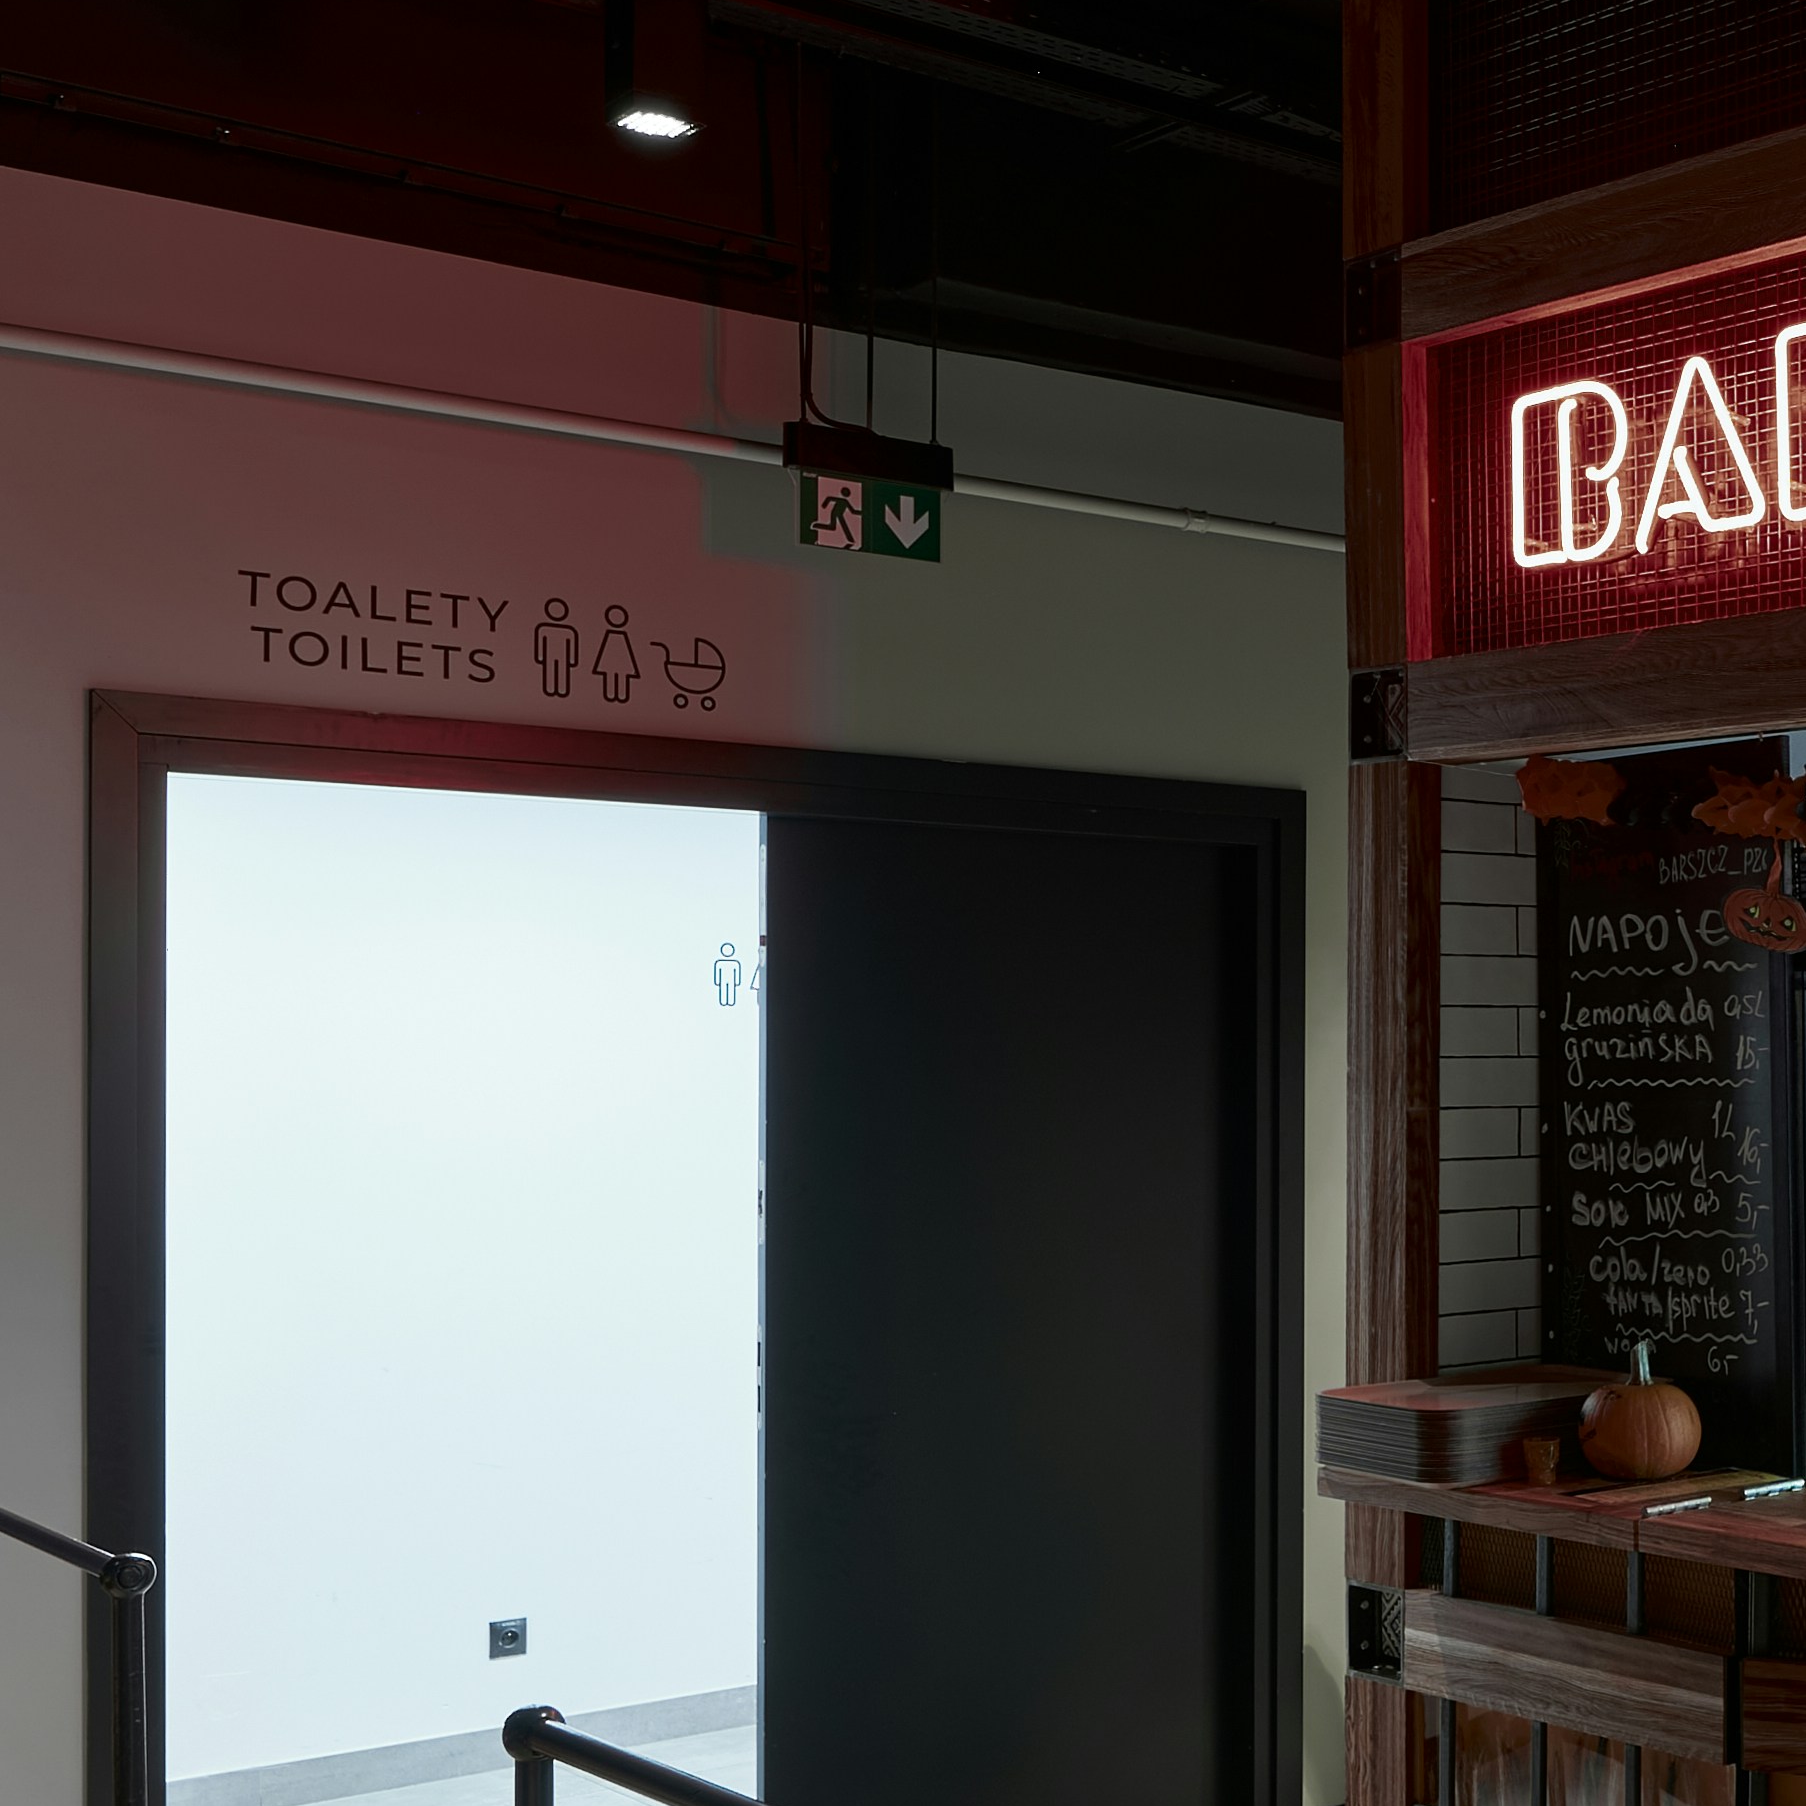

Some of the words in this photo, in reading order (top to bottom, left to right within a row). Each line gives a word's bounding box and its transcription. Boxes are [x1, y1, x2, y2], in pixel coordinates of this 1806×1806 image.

[237, 569, 510, 633] TOALETY
[250, 625, 496, 684] TOILETS
[1646, 1190, 1685, 1229] MIX
